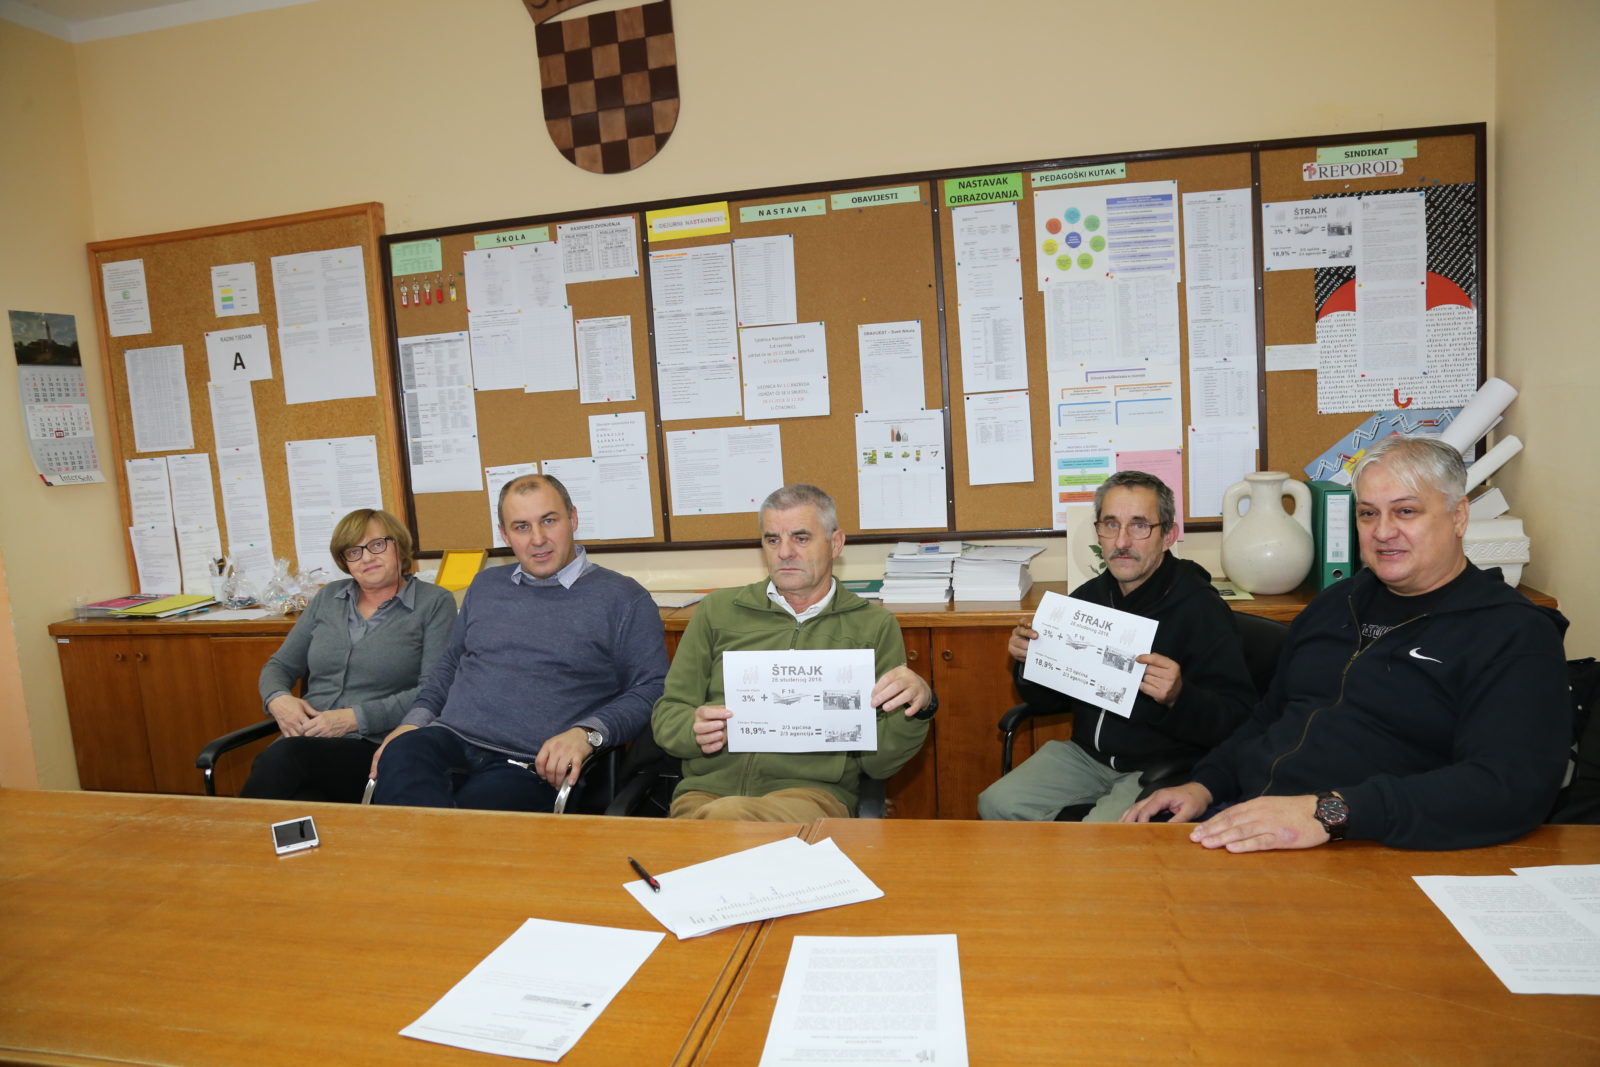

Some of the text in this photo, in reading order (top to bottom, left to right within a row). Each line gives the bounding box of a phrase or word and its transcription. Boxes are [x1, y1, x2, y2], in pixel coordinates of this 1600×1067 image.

[1344, 148, 1388, 158] SINDIKAT
[1039, 168, 1116, 183] PEDAGOŠKI KUTAK
[958, 177, 1008, 190] NASTAVAK
[851, 193, 898, 204] OBAVIJESTI
[950, 190, 1018, 204] OBRAZOVANJA
[758, 206, 807, 217] NASTAVA
[1294, 207, 1327, 216] ŠTRAJK
[496, 233, 526, 244] ŠKOLA
[233, 352, 246, 370] A
[1073, 610, 1114, 631] ŠTRAJK
[1043, 629, 1053, 638] 3%
[772, 664, 823, 676] ŠTRAJK
[1035, 658, 1054, 671] 18,9%
[741, 727, 766, 735] 18,9%
